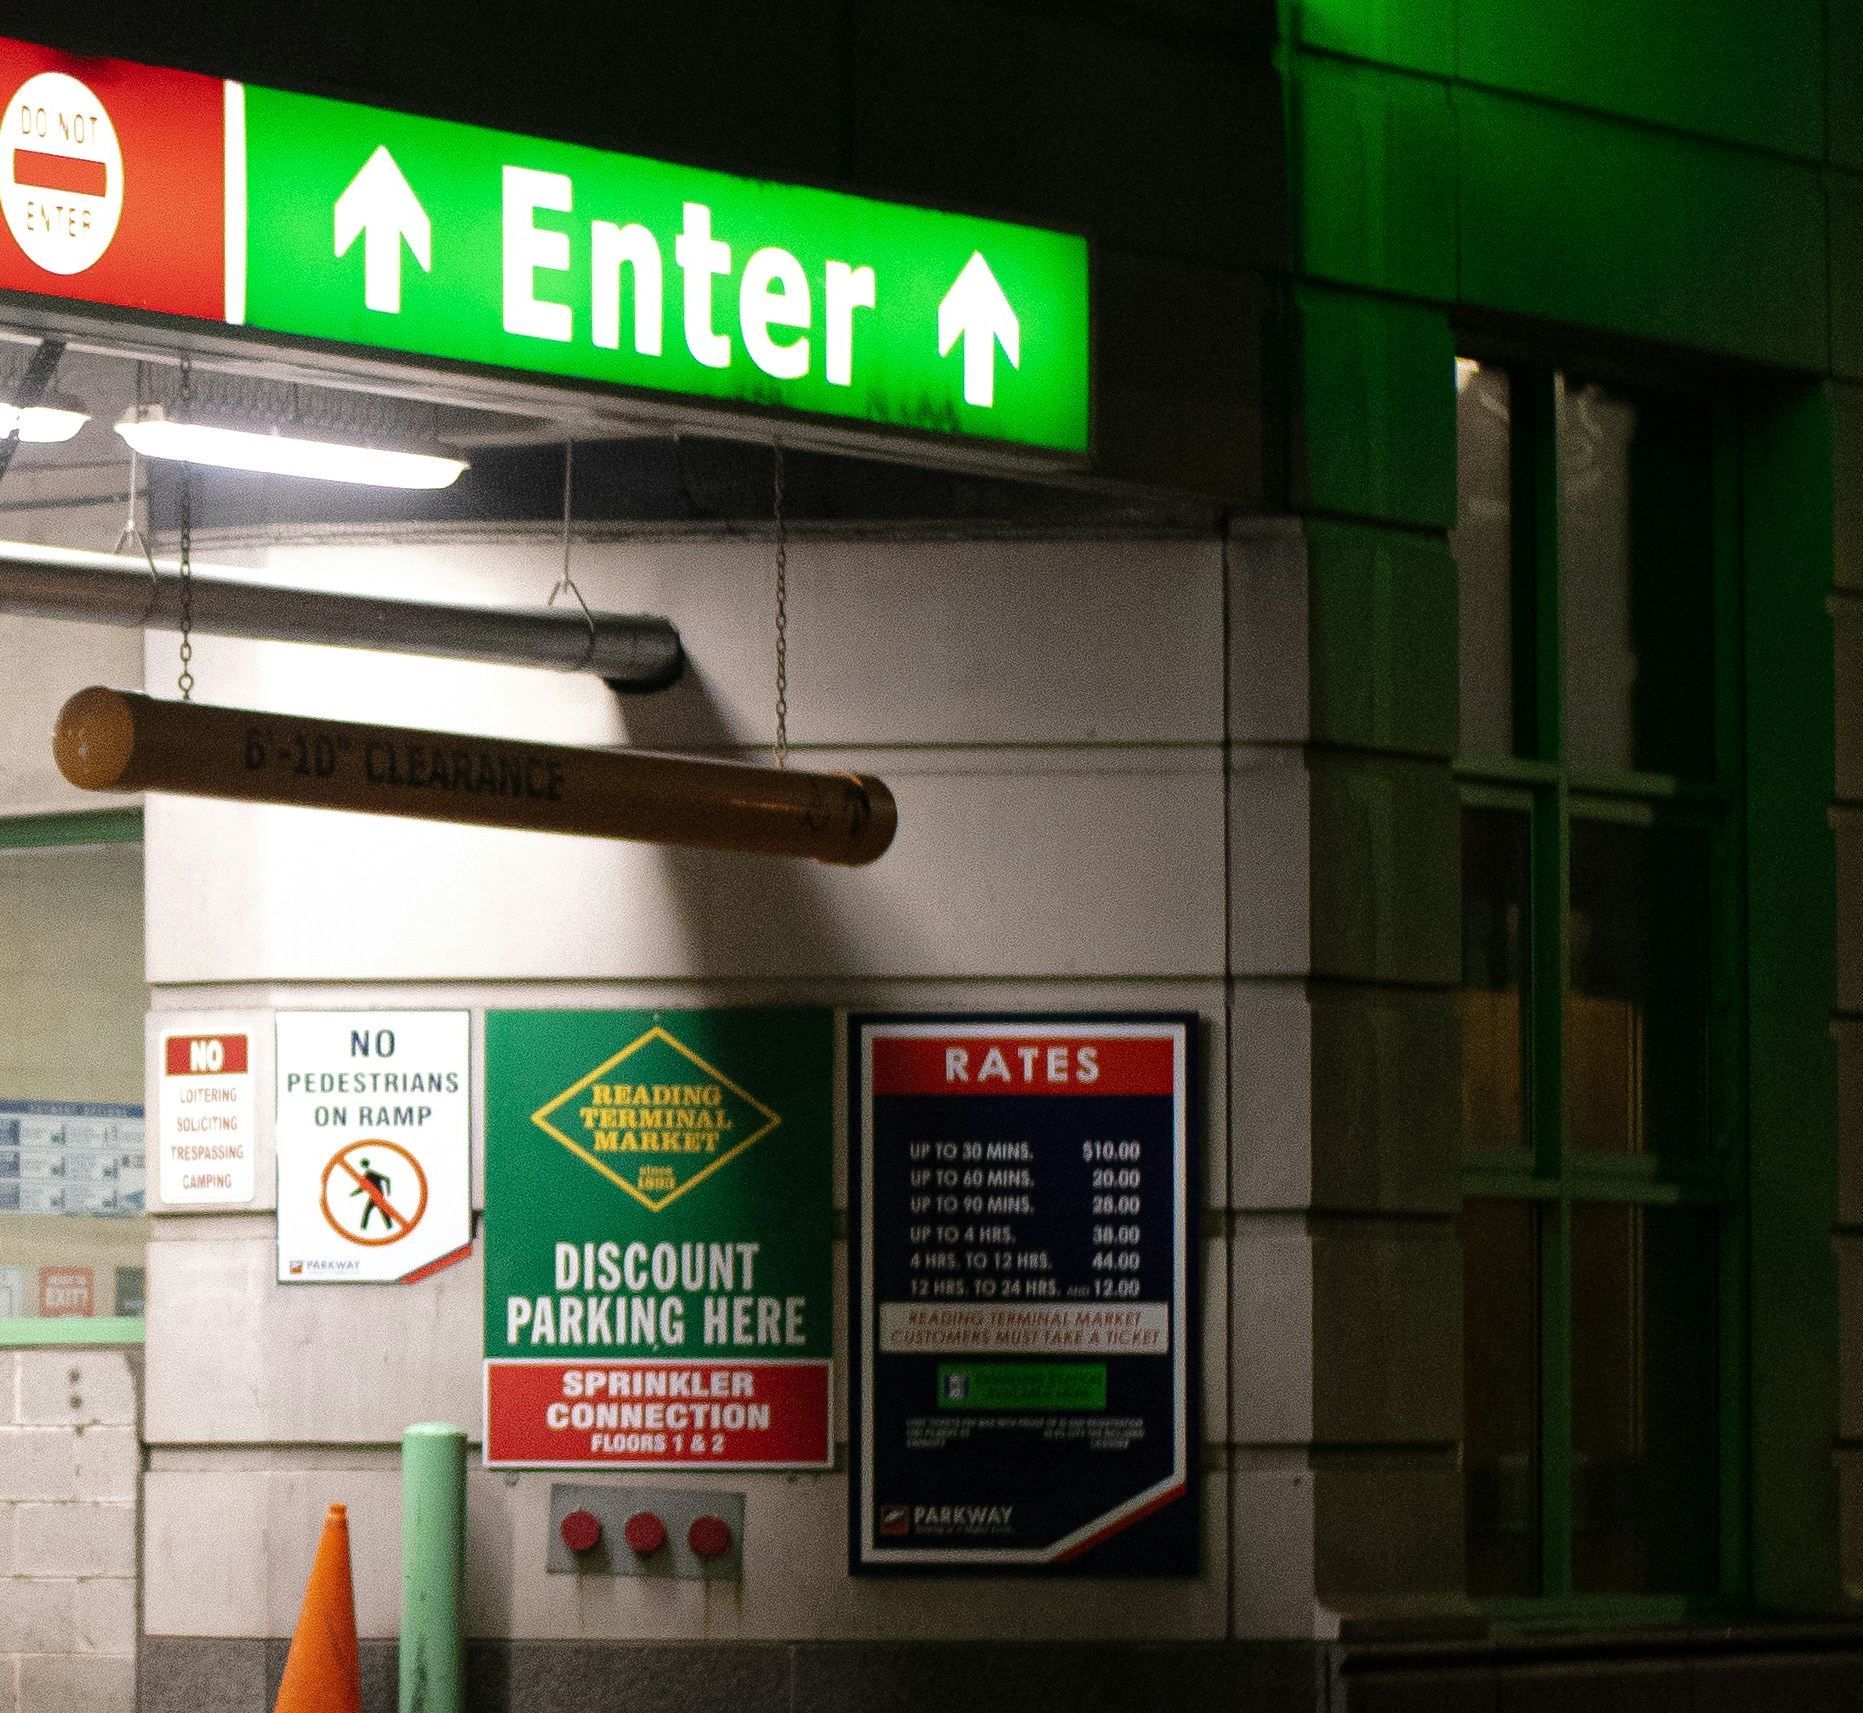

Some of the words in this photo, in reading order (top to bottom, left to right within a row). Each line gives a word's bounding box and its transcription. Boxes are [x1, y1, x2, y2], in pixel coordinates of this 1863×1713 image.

[22, 105, 47, 137] DO
[59, 112, 98, 144] NOT
[27, 201, 91, 239] ENTER
[502, 164, 877, 386] Enter
[364, 738, 565, 802] CLEARANCE
[350, 1029, 396, 1058] NO
[189, 1040, 224, 1072] NO
[945, 1047, 1100, 1084] RATES
[287, 1072, 459, 1094] PEDESTRIANS
[180, 1088, 237, 1104] LOITERING
[592, 1084, 722, 1106] READING
[177, 1116, 237, 1132] SOLICITING
[314, 1106, 347, 1127] ON
[359, 1106, 433, 1127] RAMP
[580, 1107, 733, 1130] TERMINAL
[594, 1130, 719, 1153] MARKET
[910, 1142, 930, 1161] UP
[935, 1142, 957, 1161] TO
[963, 1142, 982, 1161] 30
[986, 1142, 1033, 1161] MINS.
[1082, 1142, 1140, 1161] $10.00
[170, 1144, 244, 1161] TRESPASSING
[182, 1173, 232, 1190] CAMPING
[911, 1169, 931, 1188] UP
[936, 1169, 958, 1188] TO
[963, 1169, 983, 1188] 60
[987, 1169, 1034, 1188] MINS.
[911, 1196, 931, 1215] UP
[936, 1196, 958, 1215] TO
[963, 1196, 983, 1215] 90
[987, 1196, 1034, 1215] MINS.
[911, 1225, 931, 1244] UP
[937, 1225, 958, 1244] TO
[964, 1225, 974, 1244] 4
[307, 1260, 360, 1270] PARKWAY
[554, 1242, 760, 1291] DISCOUNT
[910, 1253, 920, 1271] 4
[967, 1253, 987, 1271] TO
[994, 1253, 1012, 1271] 12
[1092, 1253, 1140, 1271] 44.00
[911, 1279, 928, 1298] 12
[975, 1279, 996, 1298] TO
[1001, 1279, 1021, 1298] 24
[507, 1296, 684, 1346] PARKING
[703, 1296, 807, 1346] HERE
[909, 1311, 984, 1326] READING
[991, 1311, 1068, 1326] TERMINAL
[1075, 1311, 1143, 1326] MARKET
[891, 1330, 989, 1345] CUSTOMERS
[995, 1330, 1038, 1345] MUST
[1044, 1330, 1082, 1345] TAKE
[1088, 1330, 1100, 1345] A
[1107, 1330, 1159, 1345] TICKET
[562, 1371, 755, 1398] SPRINKLER
[546, 1402, 770, 1431] CONNECTION
[592, 1434, 666, 1453] FLOORS
[673, 1434, 682, 1453] 1
[691, 1434, 706, 1453] &
[711, 1434, 724, 1453] 2
[914, 1505, 1014, 1524] PARKWAY
